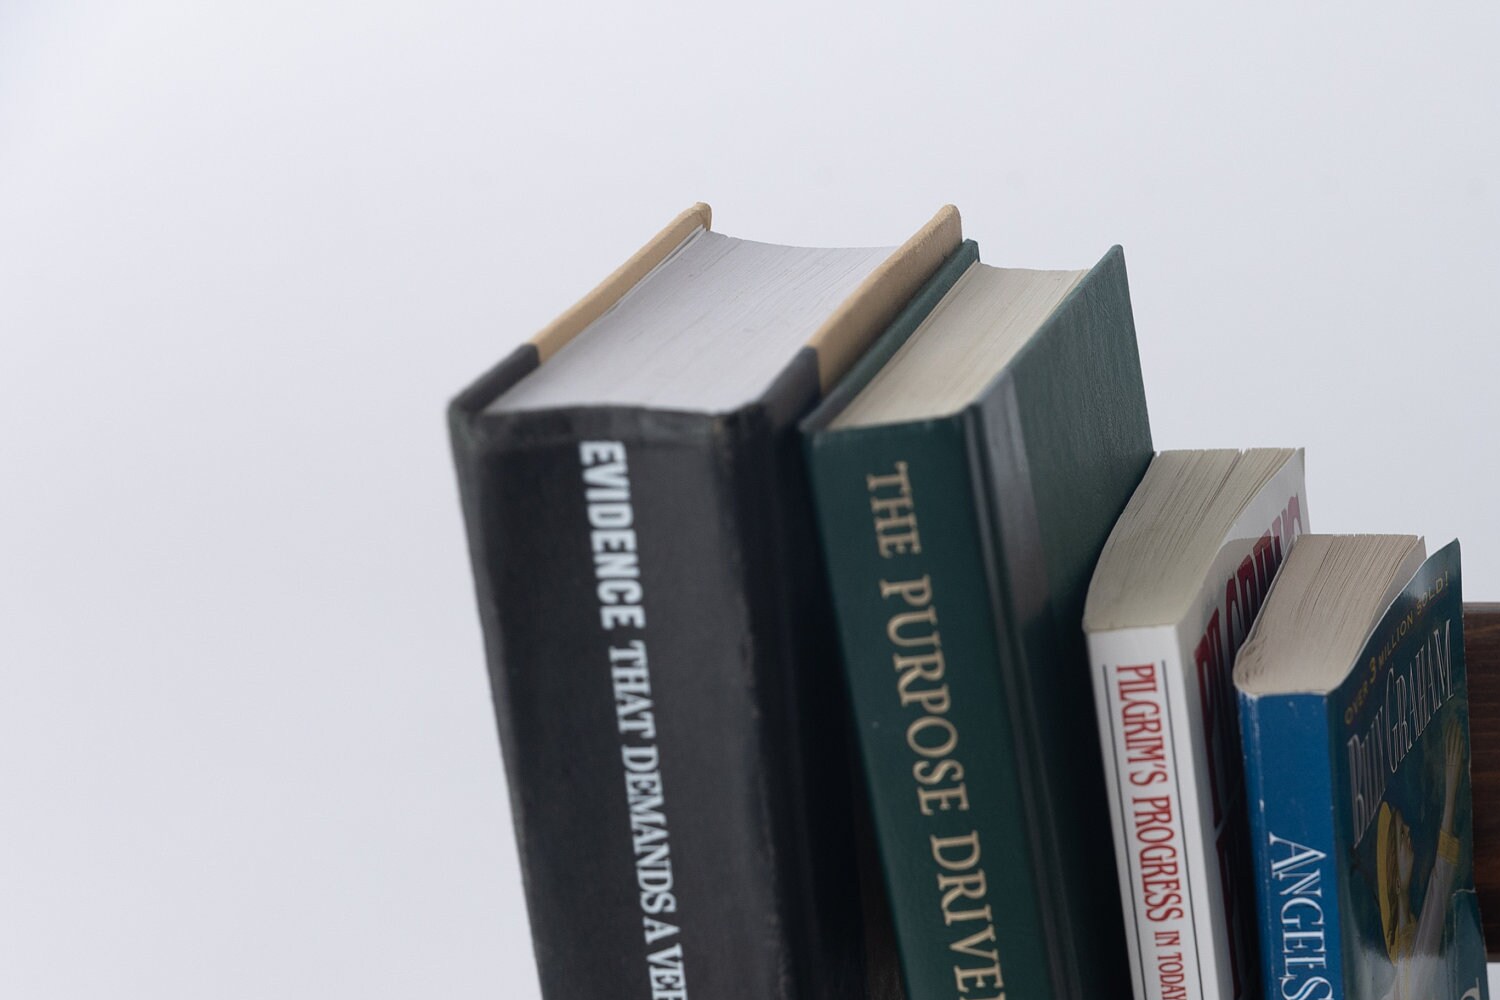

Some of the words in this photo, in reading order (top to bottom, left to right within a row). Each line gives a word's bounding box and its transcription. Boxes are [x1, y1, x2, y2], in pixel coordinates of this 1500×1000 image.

[579, 441, 645, 629] EVIDENCE
[866, 462, 921, 557] THE
[609, 640, 656, 736] THAT
[880, 575, 969, 816] PURPOSE
[1116, 663, 1168, 787] PILGRIM'S
[1385, 619, 1455, 774] GRAHAM
[622, 744, 676, 913] DEMANDS
[1132, 795, 1184, 922] PROGRESS
[643, 916, 680, 945] A
[1154, 931, 1181, 949] IN
